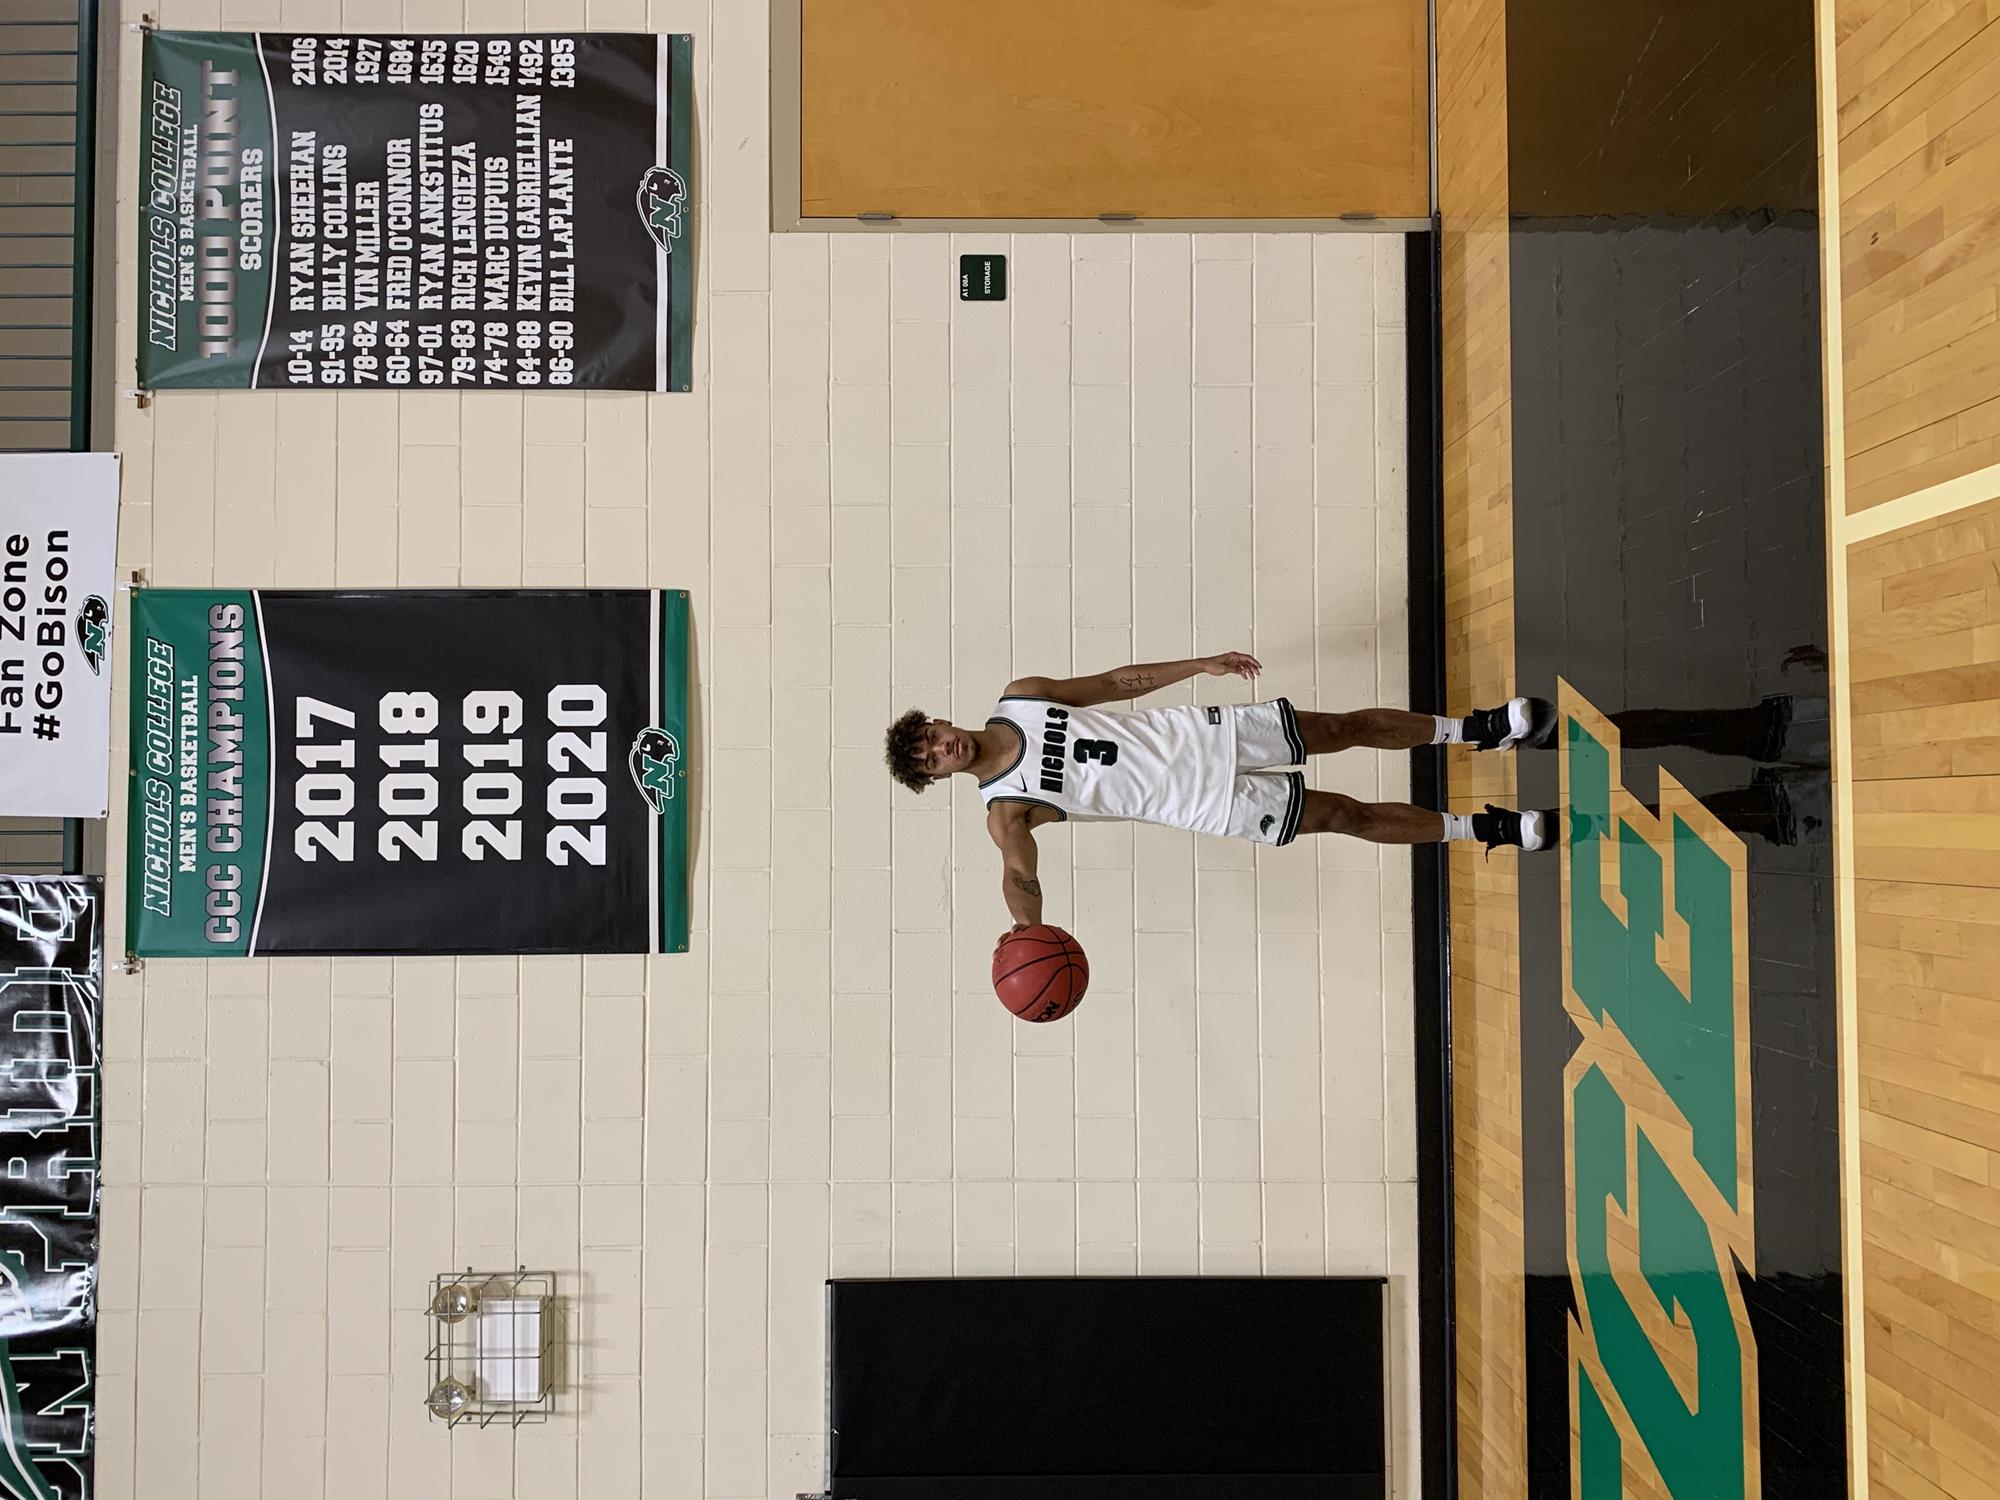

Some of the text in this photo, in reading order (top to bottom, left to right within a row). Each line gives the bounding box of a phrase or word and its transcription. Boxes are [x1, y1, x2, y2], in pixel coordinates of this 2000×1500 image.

[549, 38, 576, 88] 1385
[149, 80, 182, 351] NICHOLS COLLEGE
[178, 124, 198, 301] MEN'S BASKETBALL
[197, 59, 241, 359] 1000 POINT
[239, 148, 264, 271] SCORERS
[288, 37, 318, 384] 10-14 RYAN SHEEHAN 2106
[320, 38, 350, 384] 91-95 BILLY COLLINS 2014
[353, 38, 382, 384] 78-82 VIN MILLER 1927
[385, 39, 415, 384] 60-64 FRED O'CONNOR 1684
[418, 39, 447, 384] 97-01 RYAN ANKSTITUS 1635
[450, 40, 480, 385] 79-83 RICH LENGIEZA 1620
[483, 40, 511, 385] 74-78 MARC DUPUIS 1549
[516, 39, 544, 385] 84-88 KEVIN GABRIELLIAN 1492
[548, 264, 575, 312] BILL
[548, 320, 574, 385] 86-90
[0, 533, 29, 734] Fan Zone
[32, 530, 69, 741] #GoBison
[143, 637, 175, 917] NICHOLS COLLEGE
[178, 675, 199, 872] MEN'S BASKETBALL
[204, 602, 245, 944] CCC CHAMPIONS
[294, 695, 356, 862] 2017
[377, 690, 439, 862] 2018
[461, 689, 524, 861] 2019
[546, 684, 607, 866] 2020
[1039, 706, 1070, 794] NICHOLS
[1072, 737, 1120, 767] 3
[1562, 685, 1757, 1500] GE
